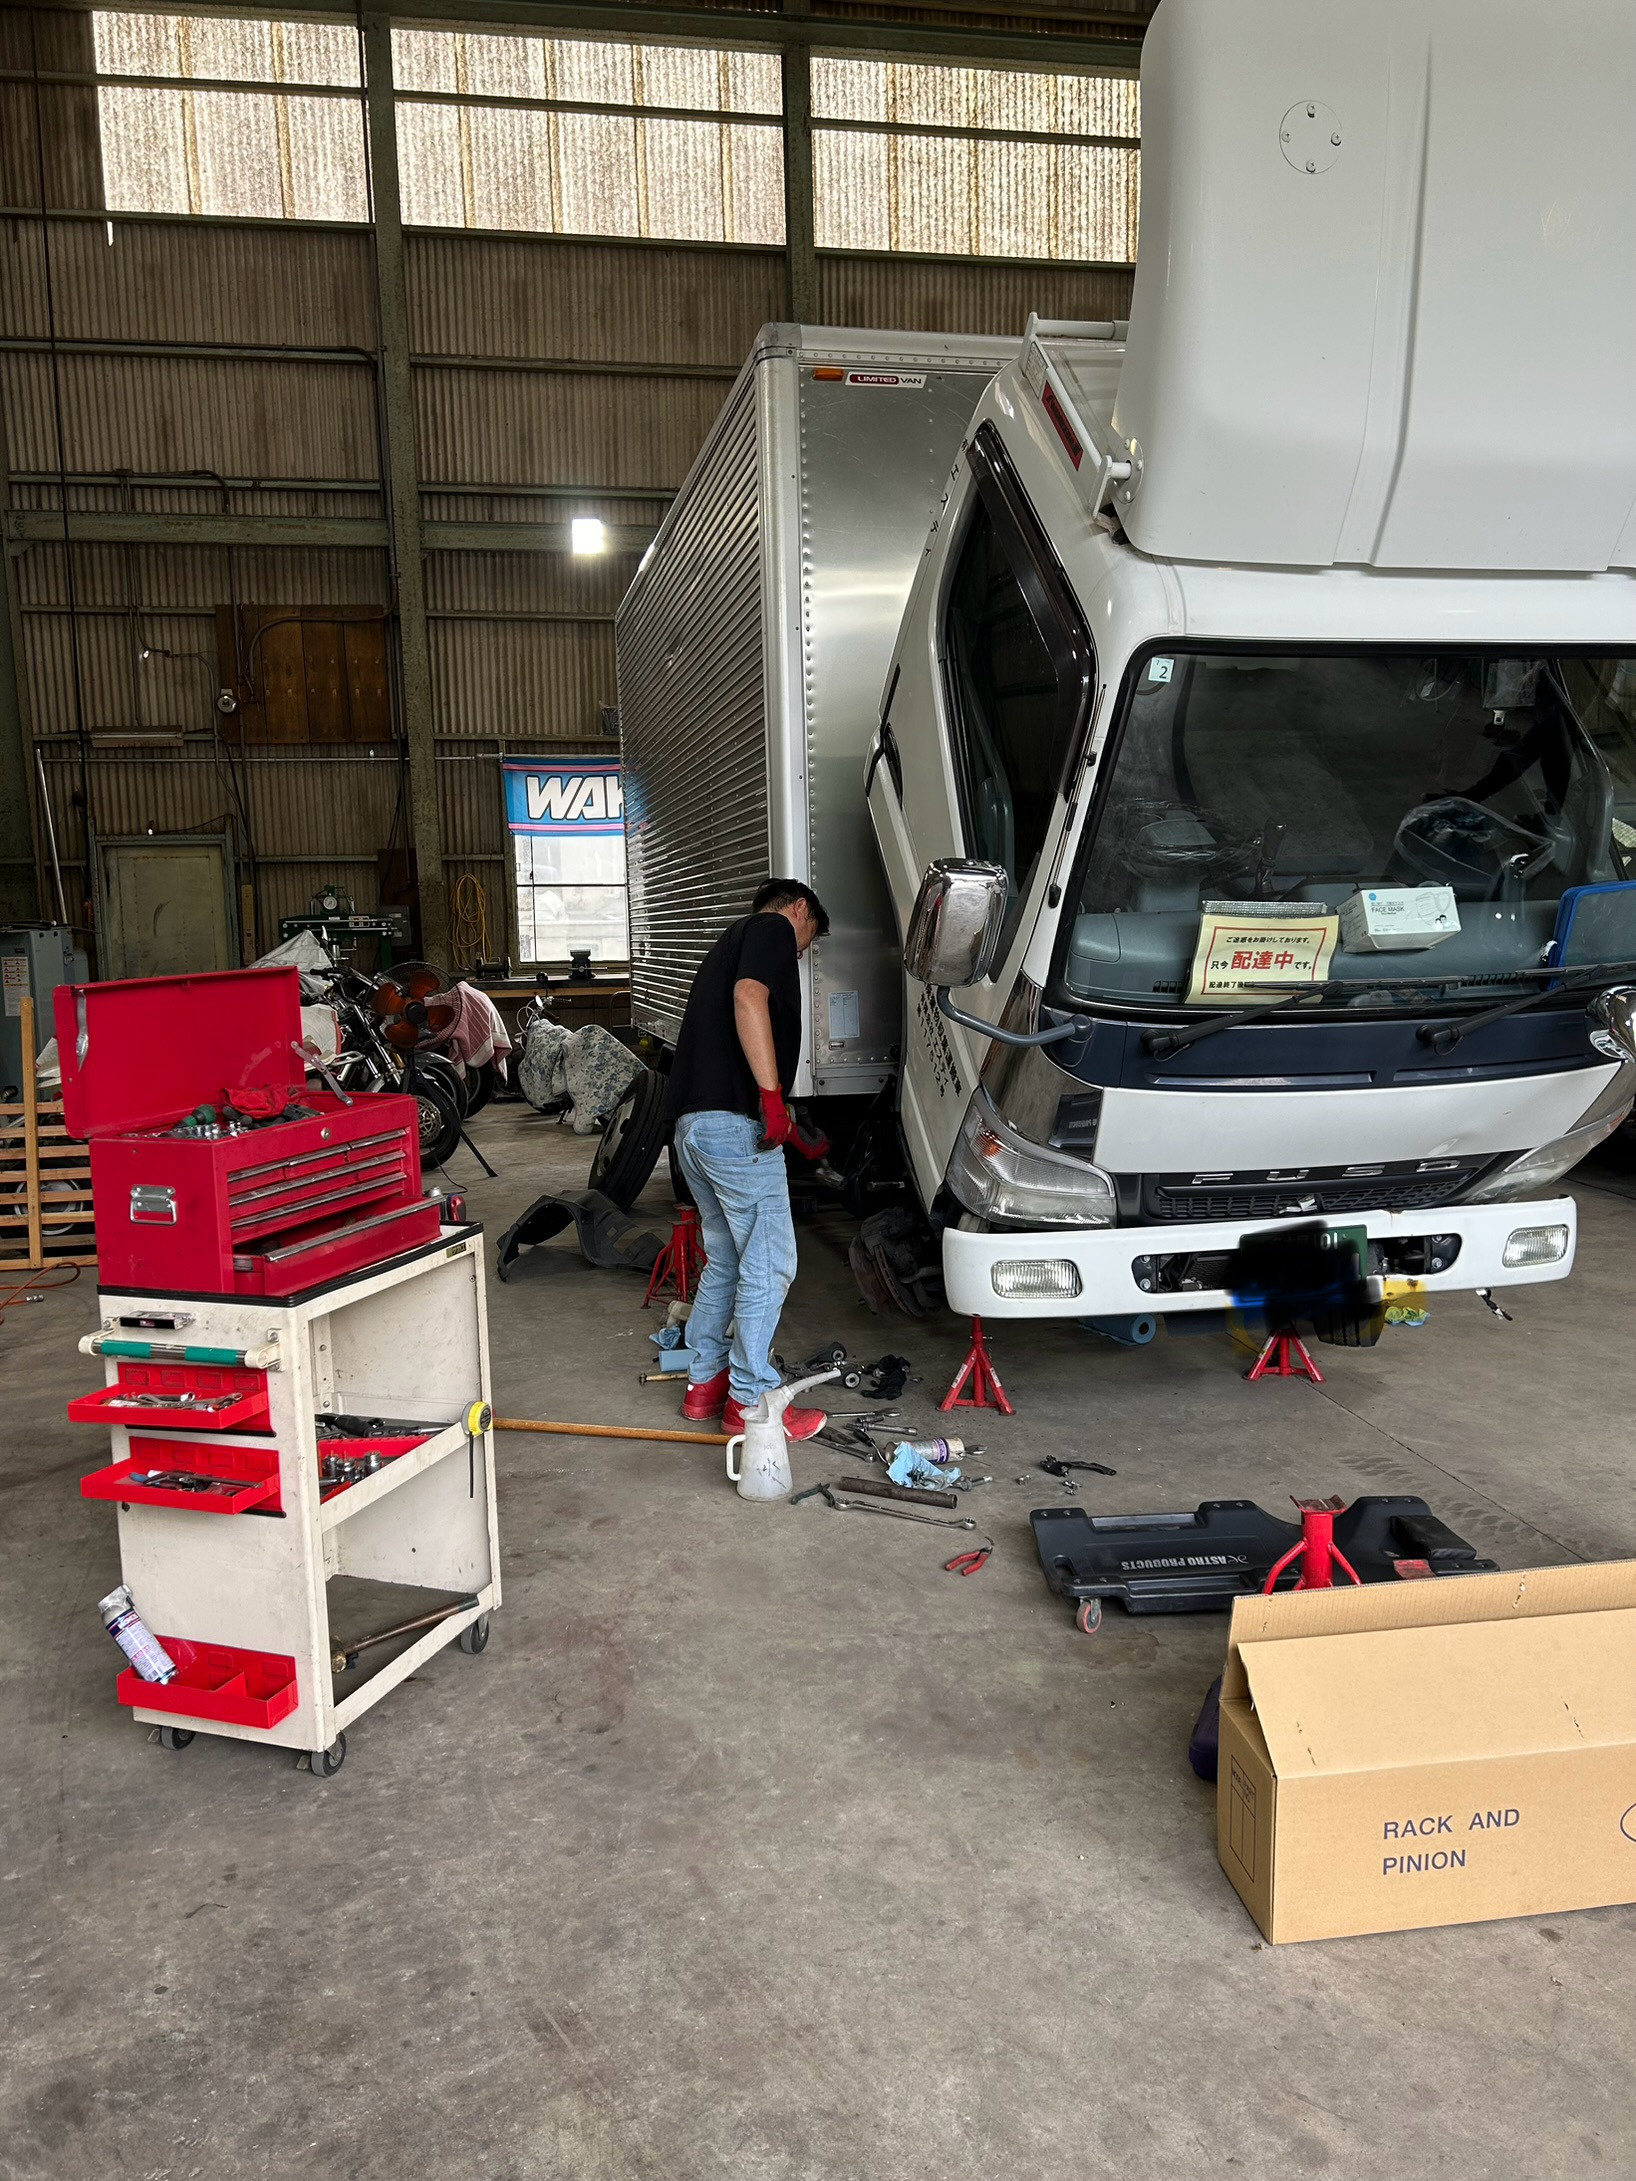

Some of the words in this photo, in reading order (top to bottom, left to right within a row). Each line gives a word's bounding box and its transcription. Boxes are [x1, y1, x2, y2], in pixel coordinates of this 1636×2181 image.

[857, 375, 897, 383] LIMITED
[1159, 665, 1168, 679] 2
[1191, 1159, 1461, 1185] FUSO
[1121, 1557, 1185, 1571] PRODUCTS
[1188, 1555, 1227, 1566] ASTRO
[1383, 1815, 1453, 1839] RACK
[1468, 1808, 1520, 1831] AND
[1383, 1849, 1466, 1875] PINION
